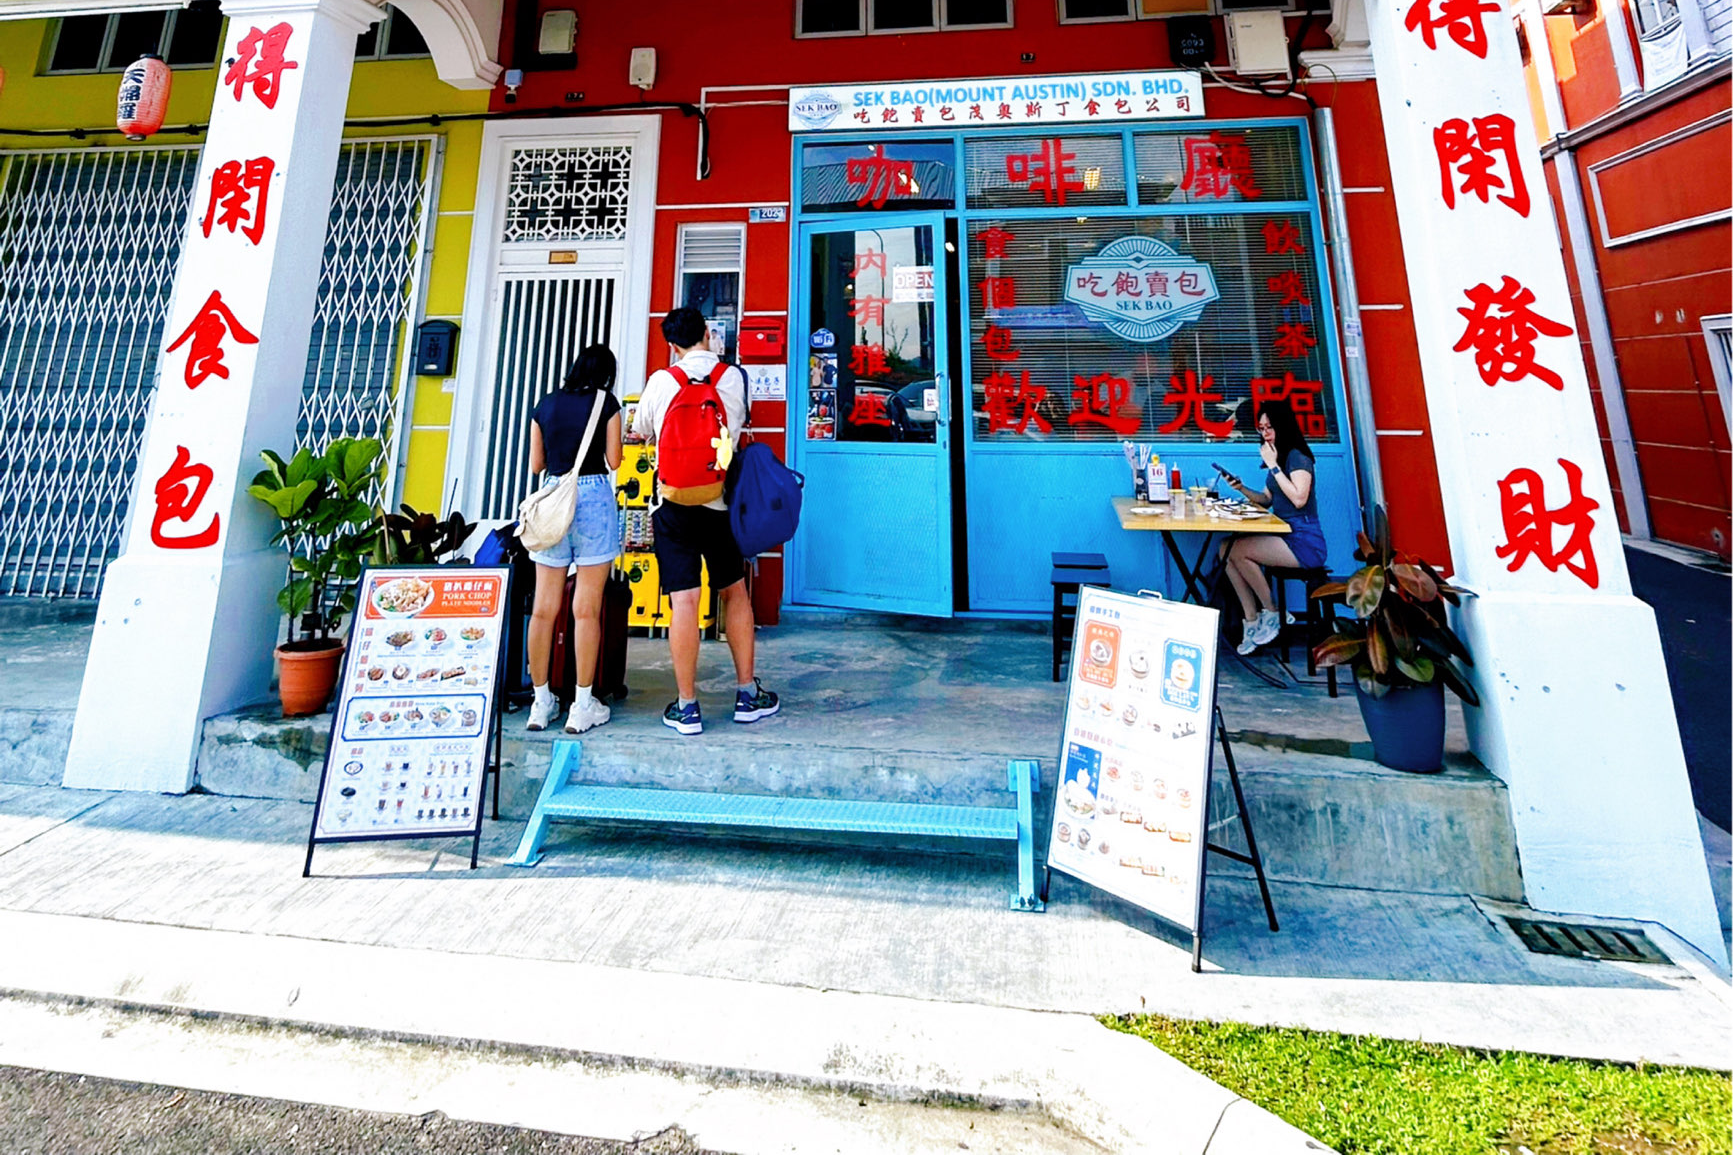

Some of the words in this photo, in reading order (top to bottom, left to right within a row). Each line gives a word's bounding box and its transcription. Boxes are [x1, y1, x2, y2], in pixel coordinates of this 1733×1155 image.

[853, 90, 884, 107] SEK
[889, 85, 1006, 107] BAO(MOUNT
[1010, 81, 1087, 103] AUSTIN)
[1091, 79, 1136, 98] SDN.
[1142, 77, 1190, 96] BHD.
[847, 131, 1262, 209] 咖啡廳
[895, 273, 934, 287] OPEN
[1077, 270, 1206, 298] 吃飽賣包
[1116, 301, 1142, 311] SEK
[1145, 300, 1173, 311] BAO
[1151, 468, 1163, 477] 16
[443, 592, 466, 600] PORK
[468, 592, 492, 600] CHOP
